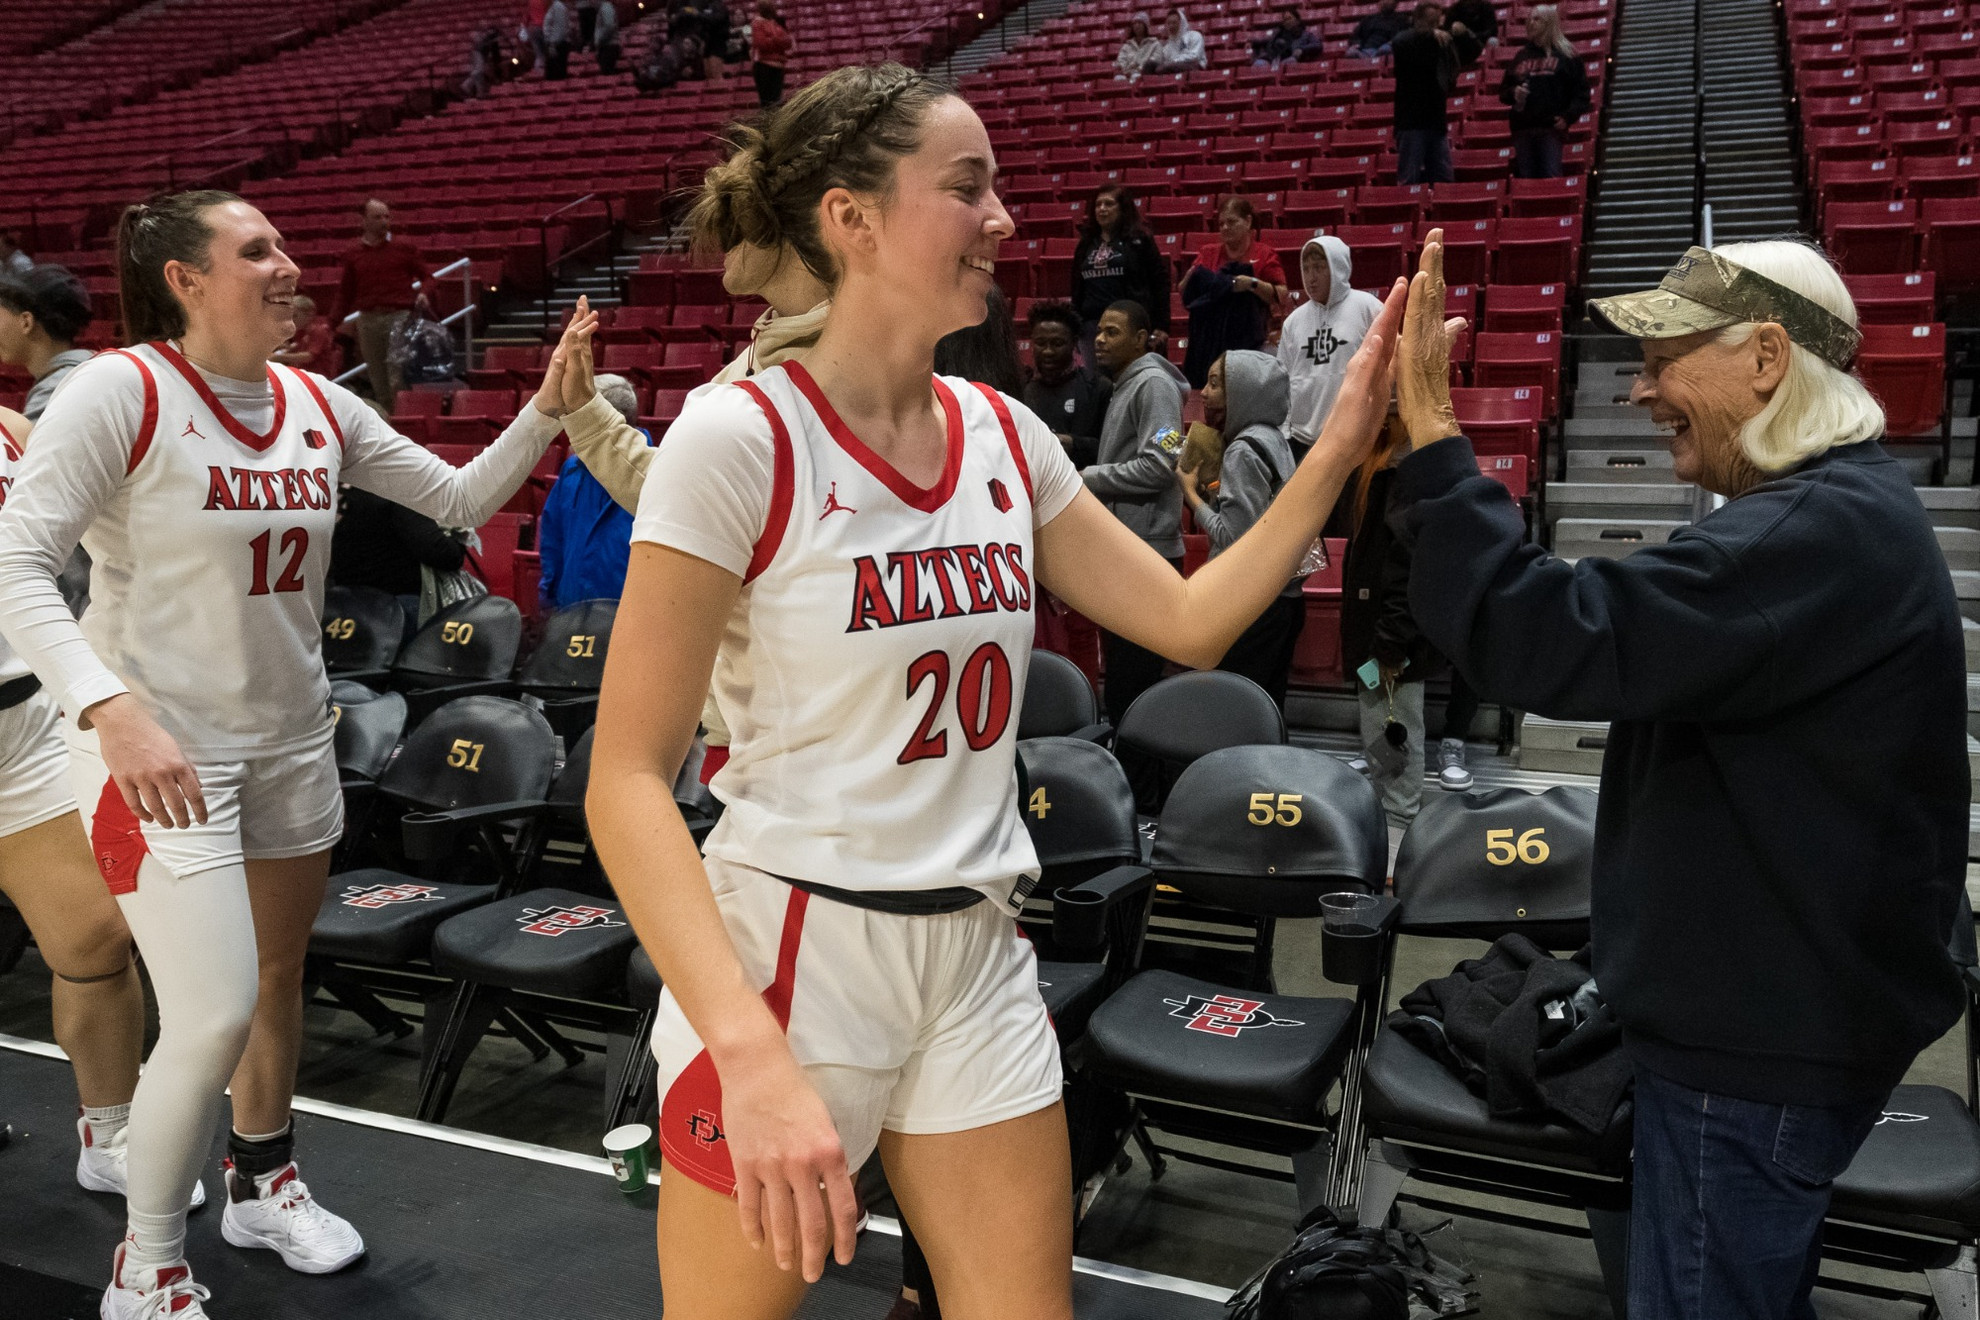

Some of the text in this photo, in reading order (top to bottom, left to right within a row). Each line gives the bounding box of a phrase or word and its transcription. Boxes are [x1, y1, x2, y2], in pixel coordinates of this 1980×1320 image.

[1516, 389, 1529, 399] 14
[1499, 458, 1511, 469] 14
[202, 465, 331, 511] AZTECS
[248, 526, 309, 596] 12
[845, 542, 1031, 633] AZTECS
[325, 617, 356, 640] 49
[441, 621, 474, 645] 50
[566, 635, 596, 657] 51
[897, 642, 1012, 765] 20
[447, 738, 484, 773] 51
[1029, 787, 1051, 819] 4
[1247, 793, 1302, 827] 55
[1485, 827, 1550, 866] 56
